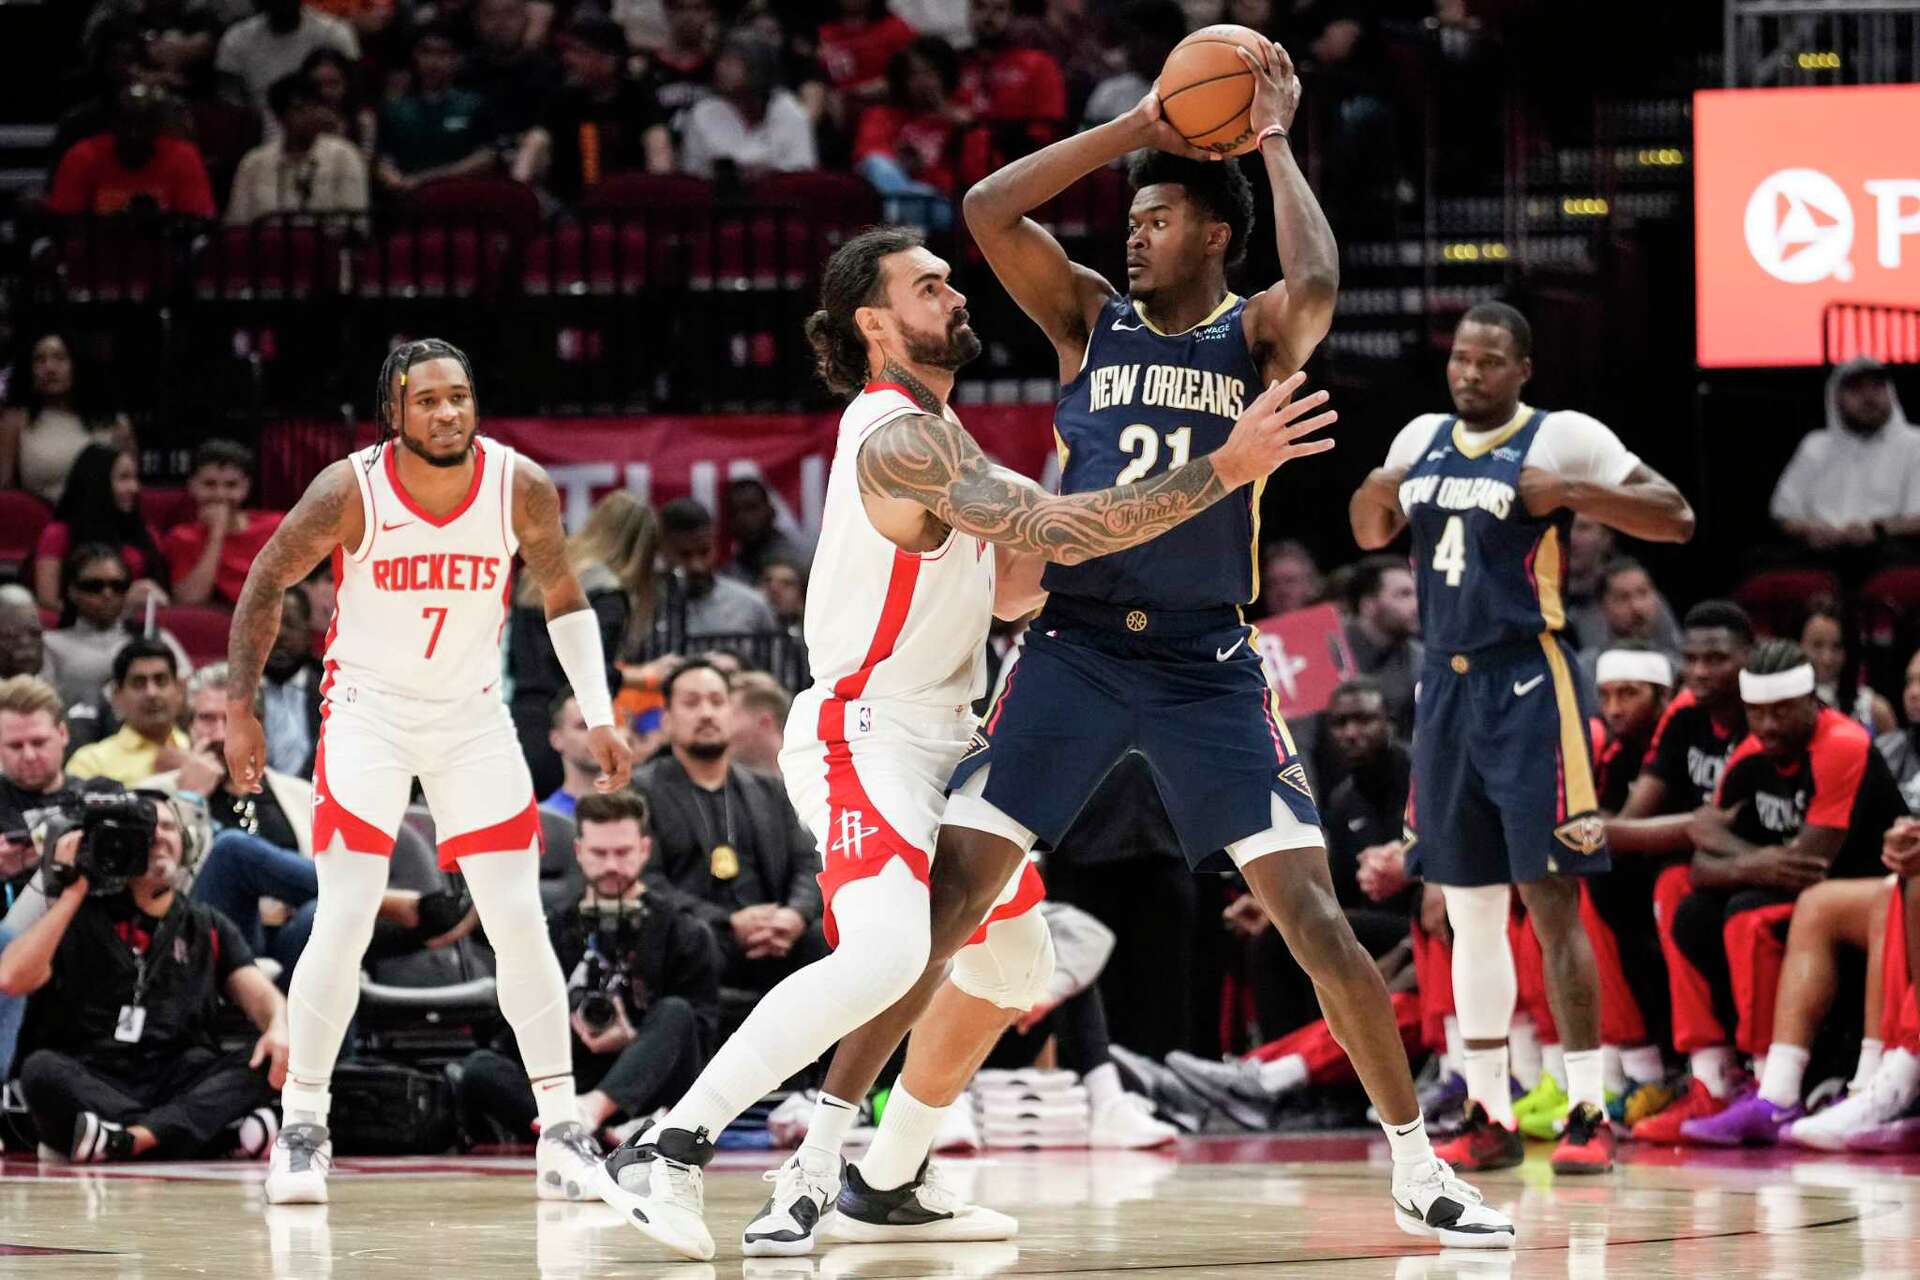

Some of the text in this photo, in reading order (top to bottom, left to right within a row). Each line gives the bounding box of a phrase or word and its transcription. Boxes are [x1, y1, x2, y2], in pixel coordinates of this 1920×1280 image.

[1089, 364, 1245, 421] NEW ORLEANS
[1115, 423, 1192, 486] 21
[373, 553, 500, 591] ROCKETS
[1432, 515, 1466, 586] 4
[422, 607, 448, 659] 7
